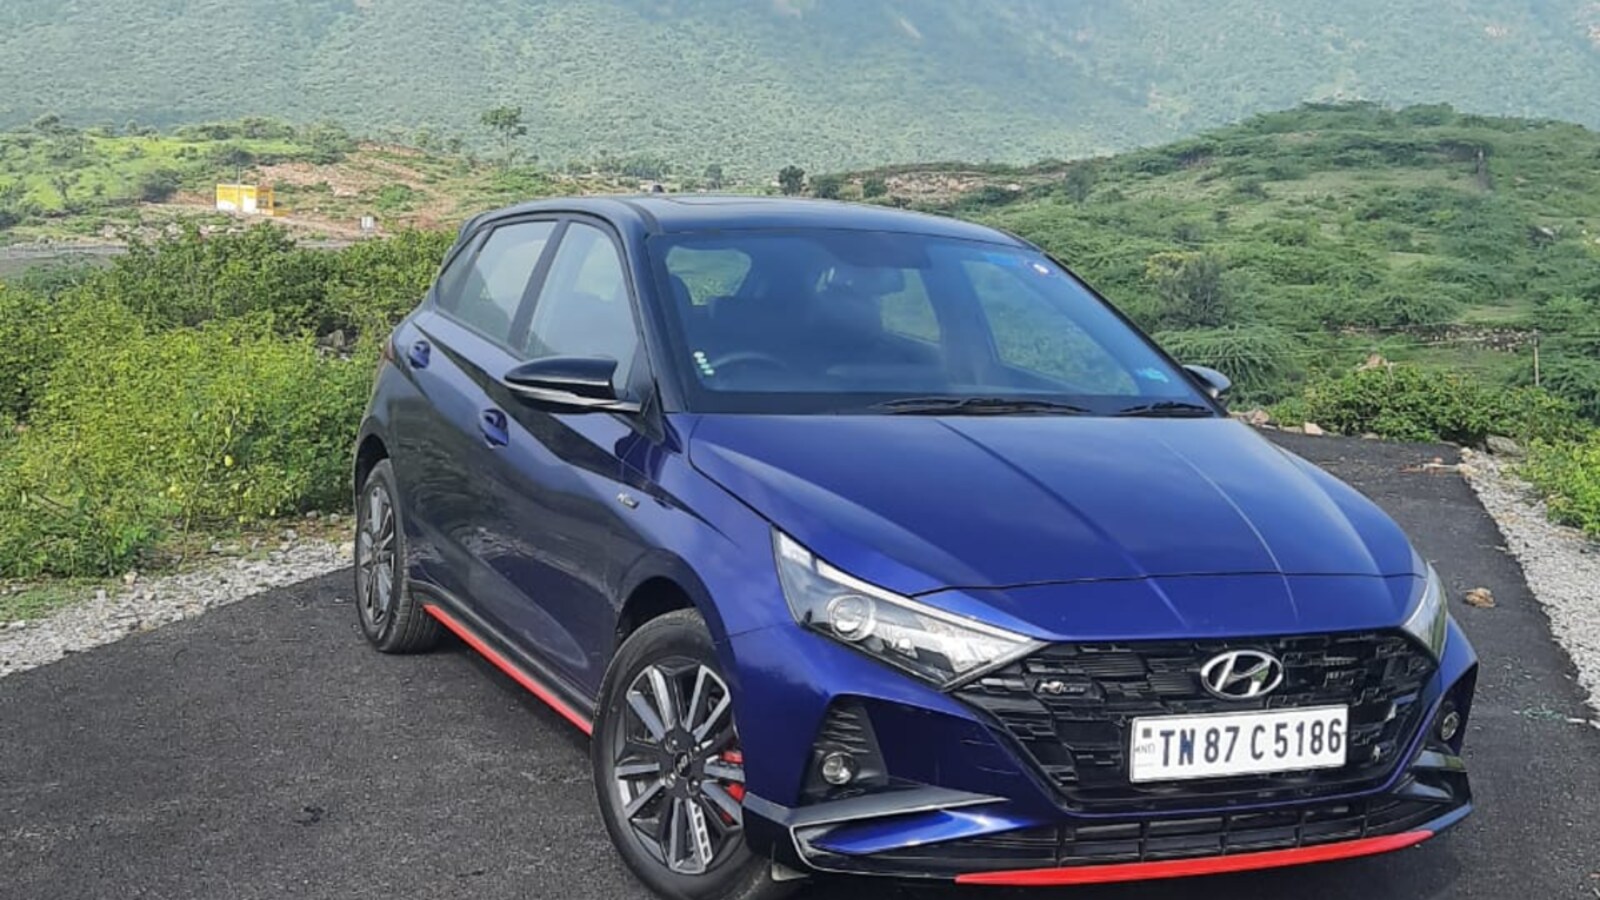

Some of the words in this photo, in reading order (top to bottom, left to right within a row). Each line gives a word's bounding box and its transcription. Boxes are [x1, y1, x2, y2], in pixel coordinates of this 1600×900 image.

[1159, 728, 1196, 767] TN
[1204, 726, 1240, 764] 87
[1250, 724, 1266, 760] C
[1274, 718, 1343, 758] 5186
